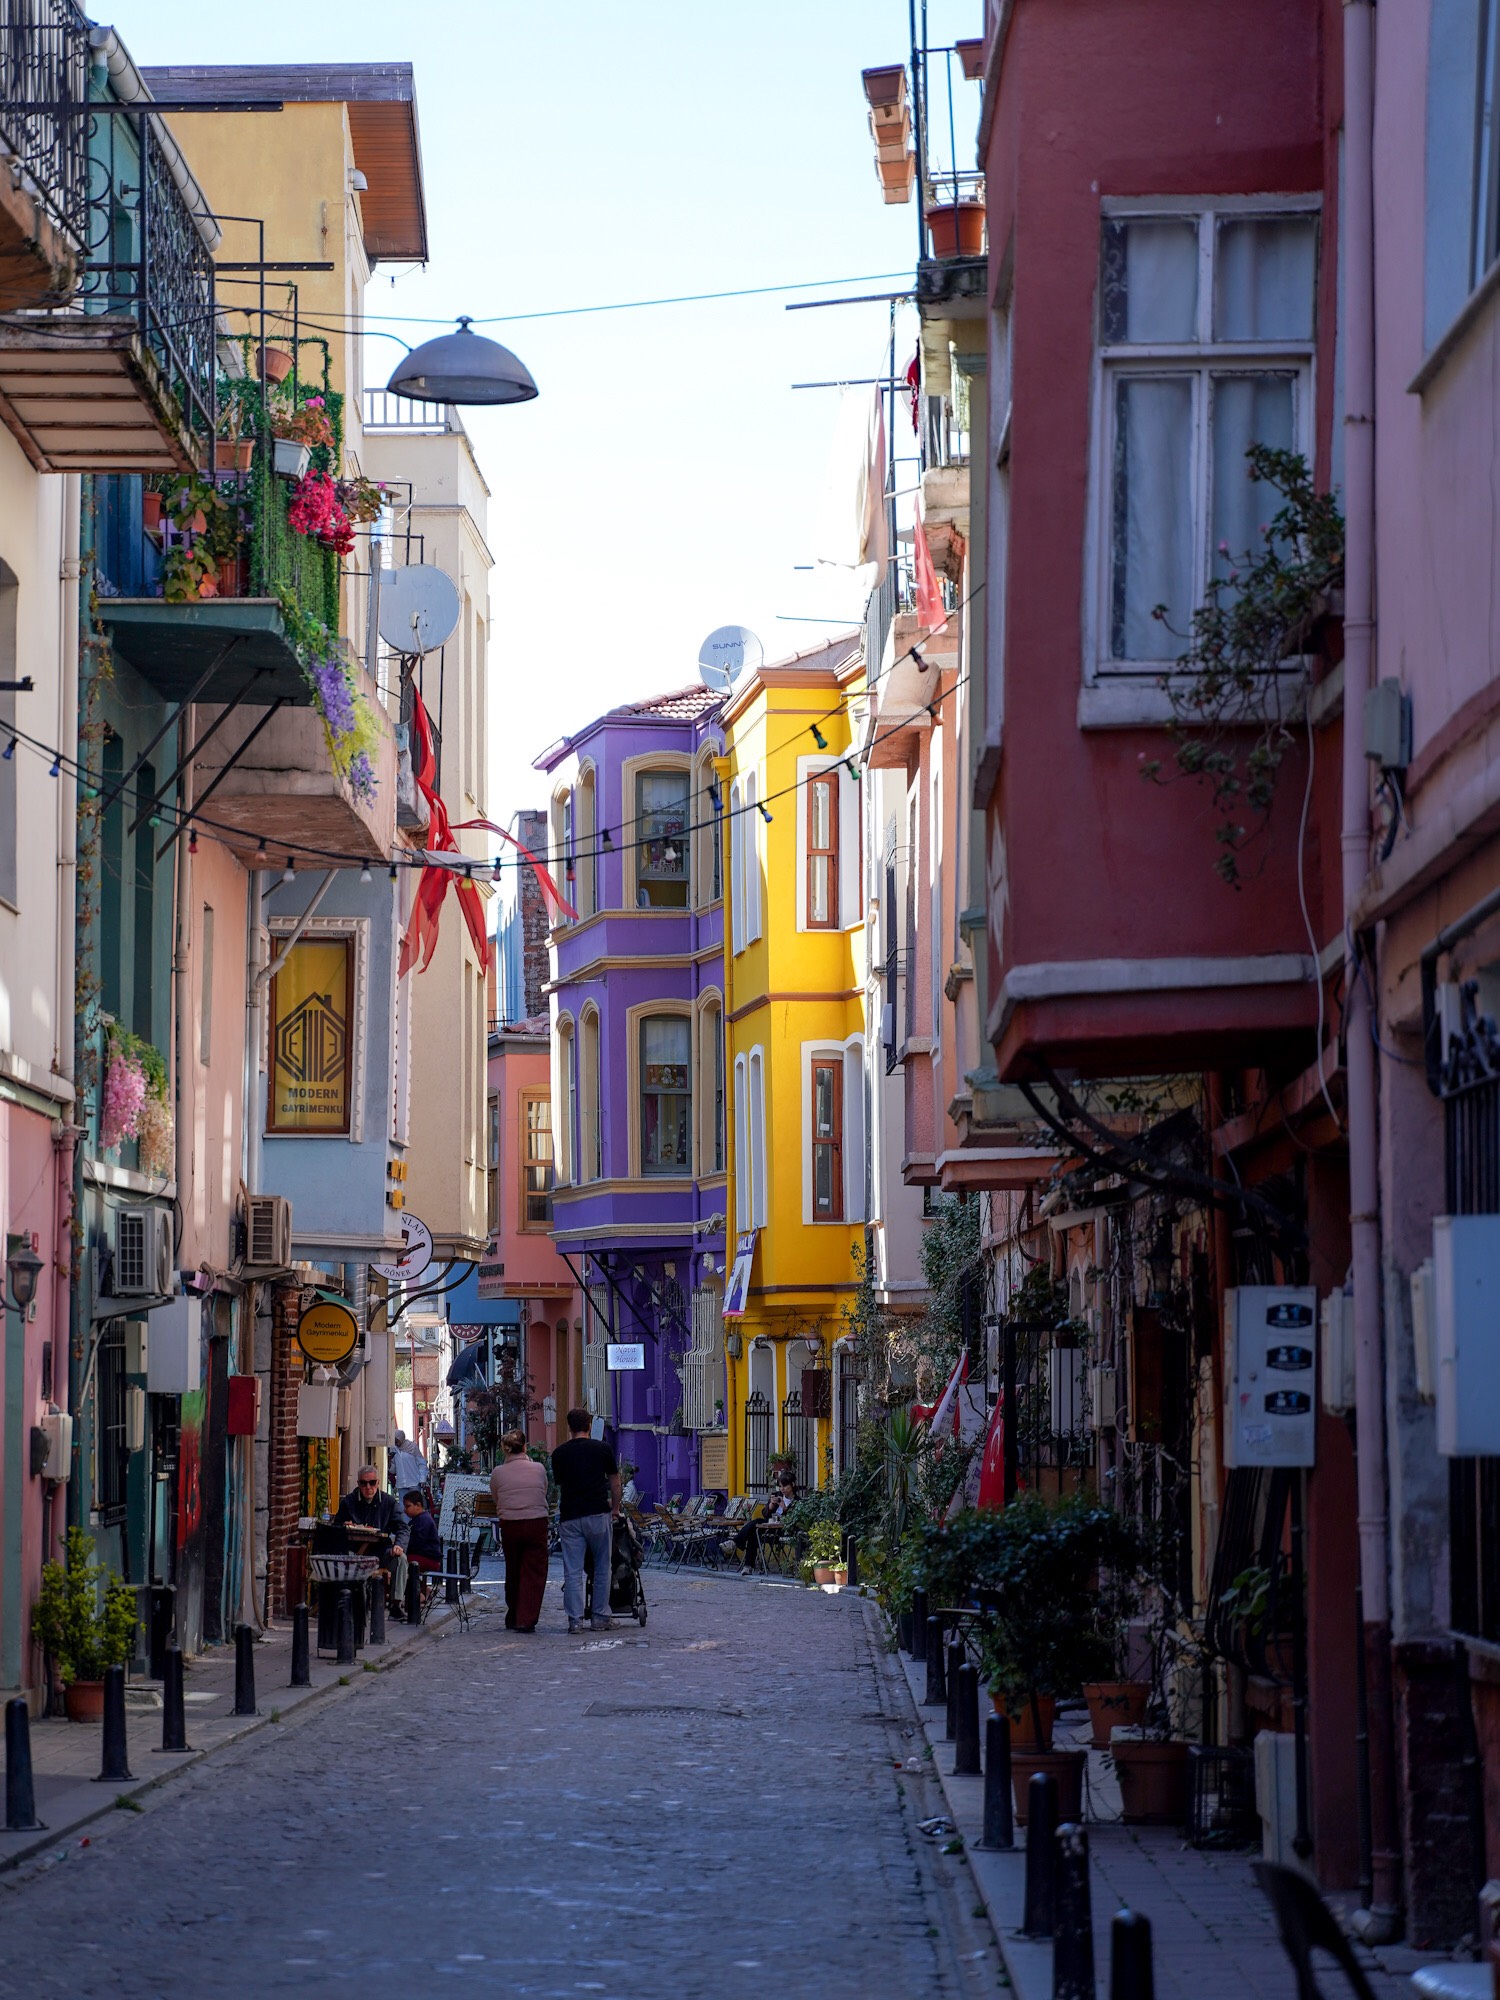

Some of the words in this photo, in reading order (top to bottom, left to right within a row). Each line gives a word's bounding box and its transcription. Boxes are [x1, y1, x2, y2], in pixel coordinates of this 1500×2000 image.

[712, 639, 747, 649] SUNNY
[288, 1087, 339, 1099] MODERN
[383, 1267, 411, 1277] DÖNER
[314, 1321, 341, 1329] Modern
[306, 1328, 349, 1337] Gayrimenkul
[453, 1325, 479, 1336] COFFEE
[614, 1354, 638, 1363] House
